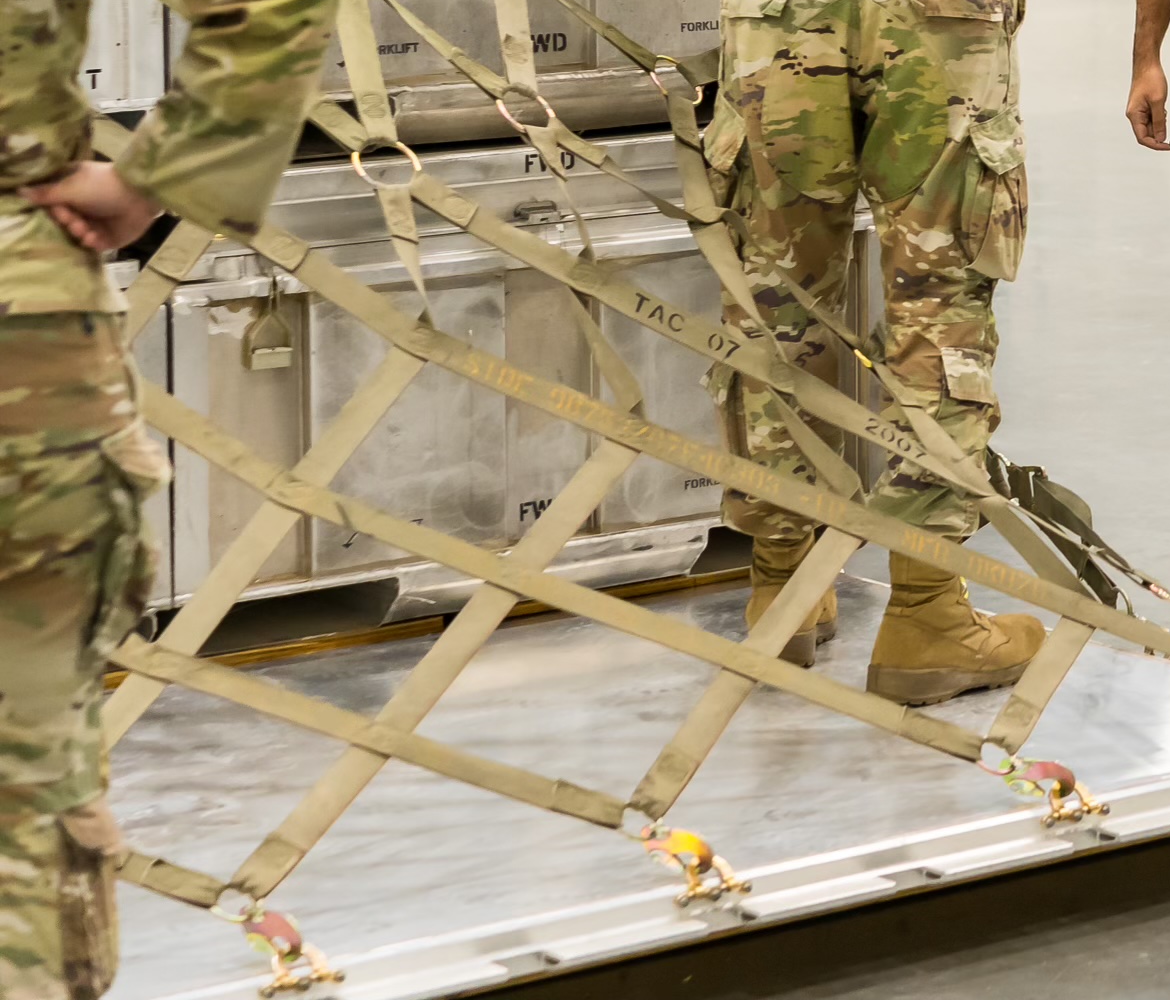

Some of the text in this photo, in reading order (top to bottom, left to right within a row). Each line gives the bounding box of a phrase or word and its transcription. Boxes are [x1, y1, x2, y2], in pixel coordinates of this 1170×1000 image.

[680, 19, 719, 33] FORKLI
[377, 42, 419, 56] RKLIFT
[530, 32, 567, 53] WD
[633, 292, 927, 460] TAC 07 2007
[519, 498, 552, 522] FW
